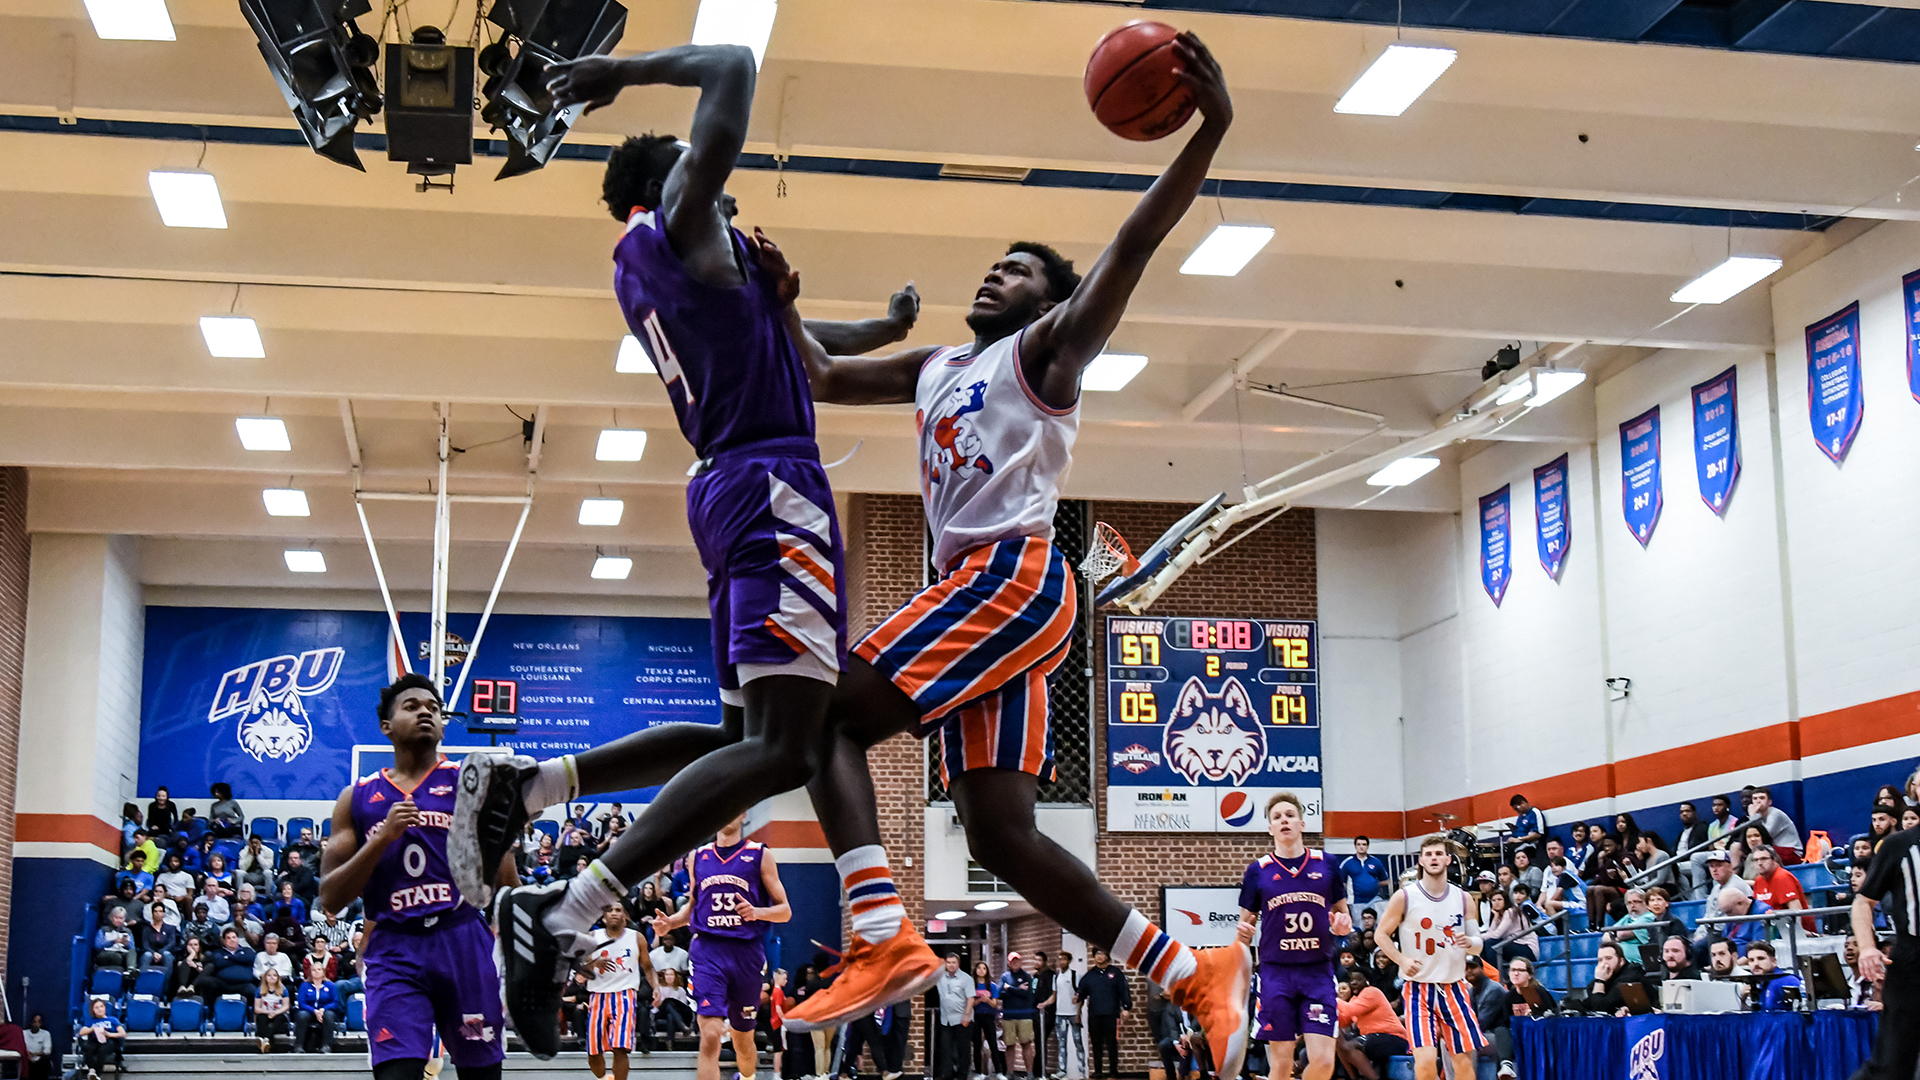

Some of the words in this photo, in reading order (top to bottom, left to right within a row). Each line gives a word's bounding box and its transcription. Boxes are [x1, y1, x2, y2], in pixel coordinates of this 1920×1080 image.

[642, 309, 695, 405] 4
[1111, 620, 1164, 635] HUSKIES
[1191, 620, 1252, 650] 8:08
[1265, 623, 1310, 638] VISITOR
[513, 642, 534, 650] NEW
[537, 642, 580, 651] ORLEANS
[648, 645, 694, 653] NICHOLLS
[1122, 634, 1160, 666] 57
[1272, 638, 1309, 668] 72
[510, 665, 583, 674] SOUTHEASTERN
[645, 667, 674, 676] TEXAS
[1206, 655, 1220, 677] 2
[208, 646, 345, 723] HBU
[521, 673, 571, 682] LOUISIANA
[635, 675, 673, 684] CORPUS
[675, 676, 712, 684] CHRISTI
[1125, 682, 1152, 692] FOULS
[1276, 685, 1302, 695] FOULS
[472, 679, 517, 714] 27
[566, 696, 595, 705] STATE
[622, 697, 665, 706] CENTRAL
[668, 698, 717, 707] ARKANSAS
[1120, 691, 1158, 723] 05
[1271, 695, 1307, 725] 04
[555, 718, 590, 727] AUSTIN
[540, 742, 591, 751] CHRISTIAN
[1266, 755, 1319, 773] NCAA
[1137, 789, 1187, 801] IRONMAN
[403, 843, 426, 878] 0
[390, 883, 452, 911] STATE
[711, 892, 736, 912] 33
[1267, 891, 1326, 911] NORTHWESTERN
[707, 915, 742, 927] STATE
[1284, 911, 1314, 933] 30
[1280, 937, 1320, 951] STATE
[1415, 931, 1436, 956] 10
[1630, 1028, 1665, 1079] HBU
